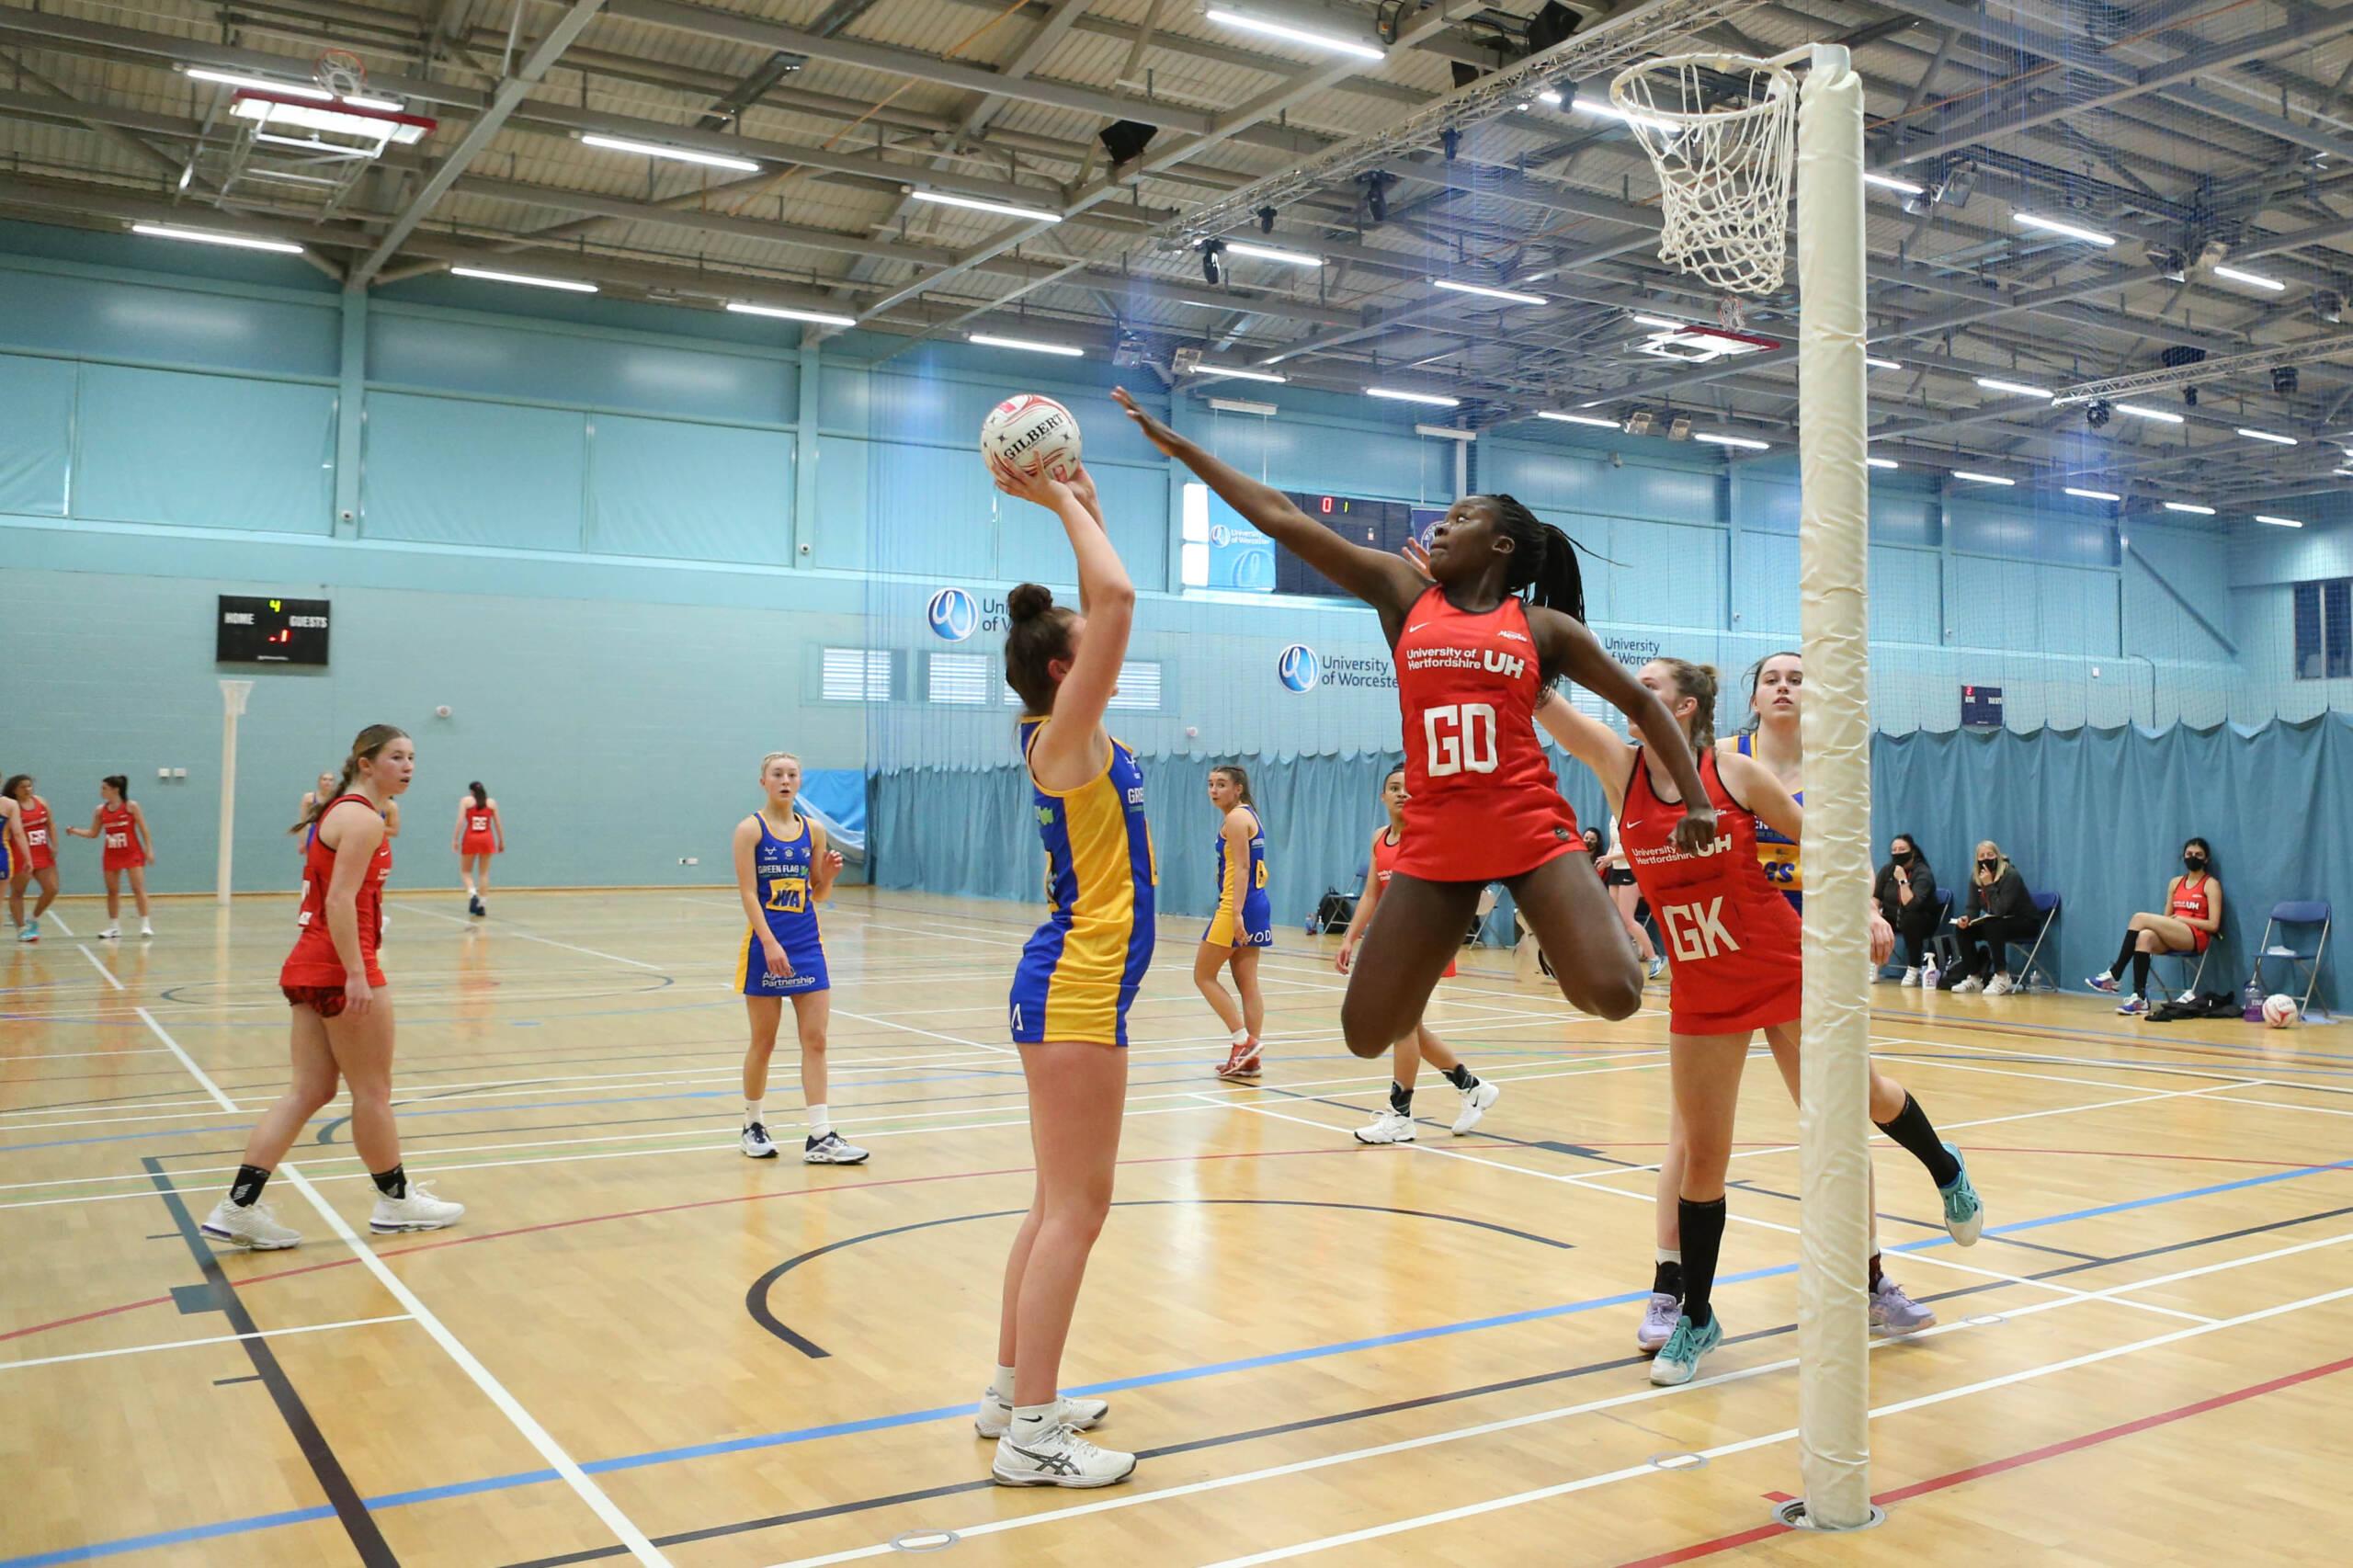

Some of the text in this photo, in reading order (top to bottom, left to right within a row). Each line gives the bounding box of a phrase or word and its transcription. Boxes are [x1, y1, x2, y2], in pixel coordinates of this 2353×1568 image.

[1004, 414, 1063, 460] GILBERT
[1322, 496, 1333, 513] 0
[268, 599, 281, 613] 4
[224, 612, 256, 625] HOME
[289, 616, 328, 628] GUESTS
[983, 616, 998, 631] of
[1406, 646, 1477, 660] University of
[1606, 636, 1660, 656] University
[1323, 655, 1389, 676] University
[1407, 657, 1481, 670] Hertfordshire
[1483, 649, 1526, 679] UH
[1322, 671, 1398, 688] of Worceste
[1424, 703, 1498, 777] GD
[1631, 846, 1677, 857] University
[757, 865, 800, 874] GREEN FLAG
[2186, 901, 2200, 910] UH
[1662, 896, 1741, 961] GK
[762, 974, 815, 987] Partnership
